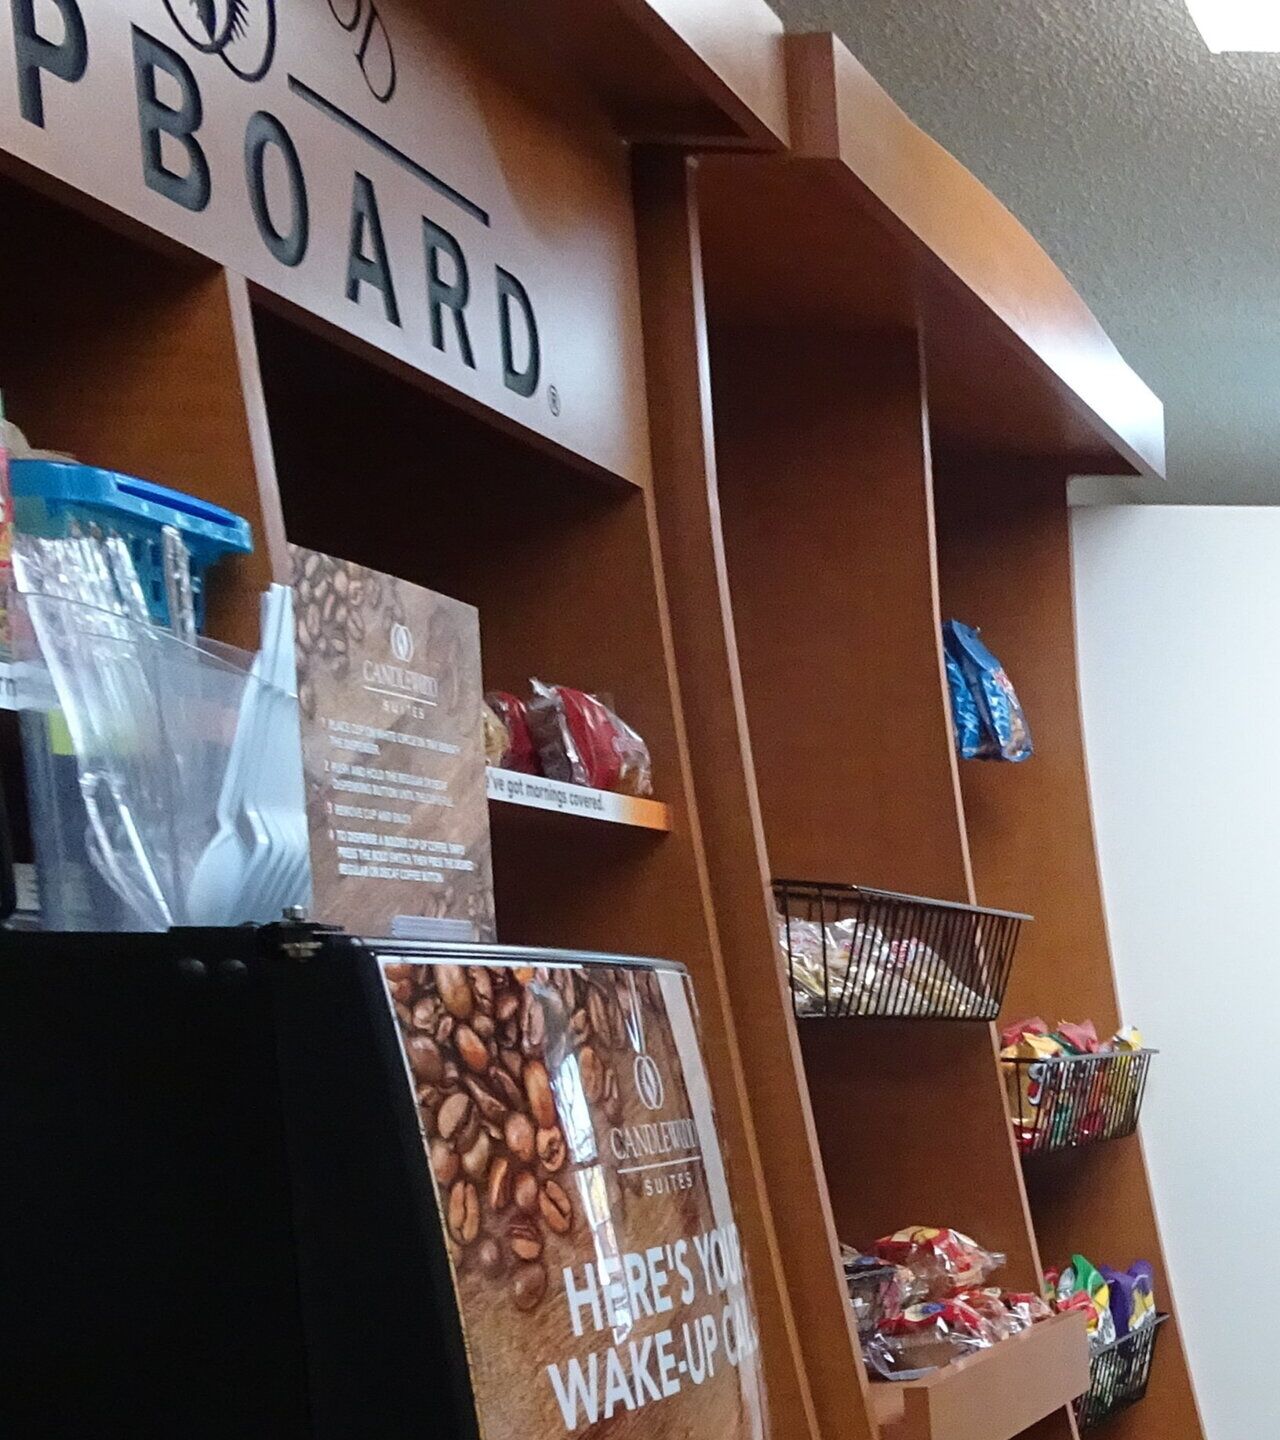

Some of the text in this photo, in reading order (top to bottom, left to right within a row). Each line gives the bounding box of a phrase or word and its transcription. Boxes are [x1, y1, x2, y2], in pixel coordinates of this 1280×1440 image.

[507, 779, 524, 799] got
[525, 784, 567, 809] mornings
[643, 1171, 693, 1197] SUITES
[562, 1238, 696, 1337] HERE'S
[546, 1313, 718, 1431] WAKE-UP
